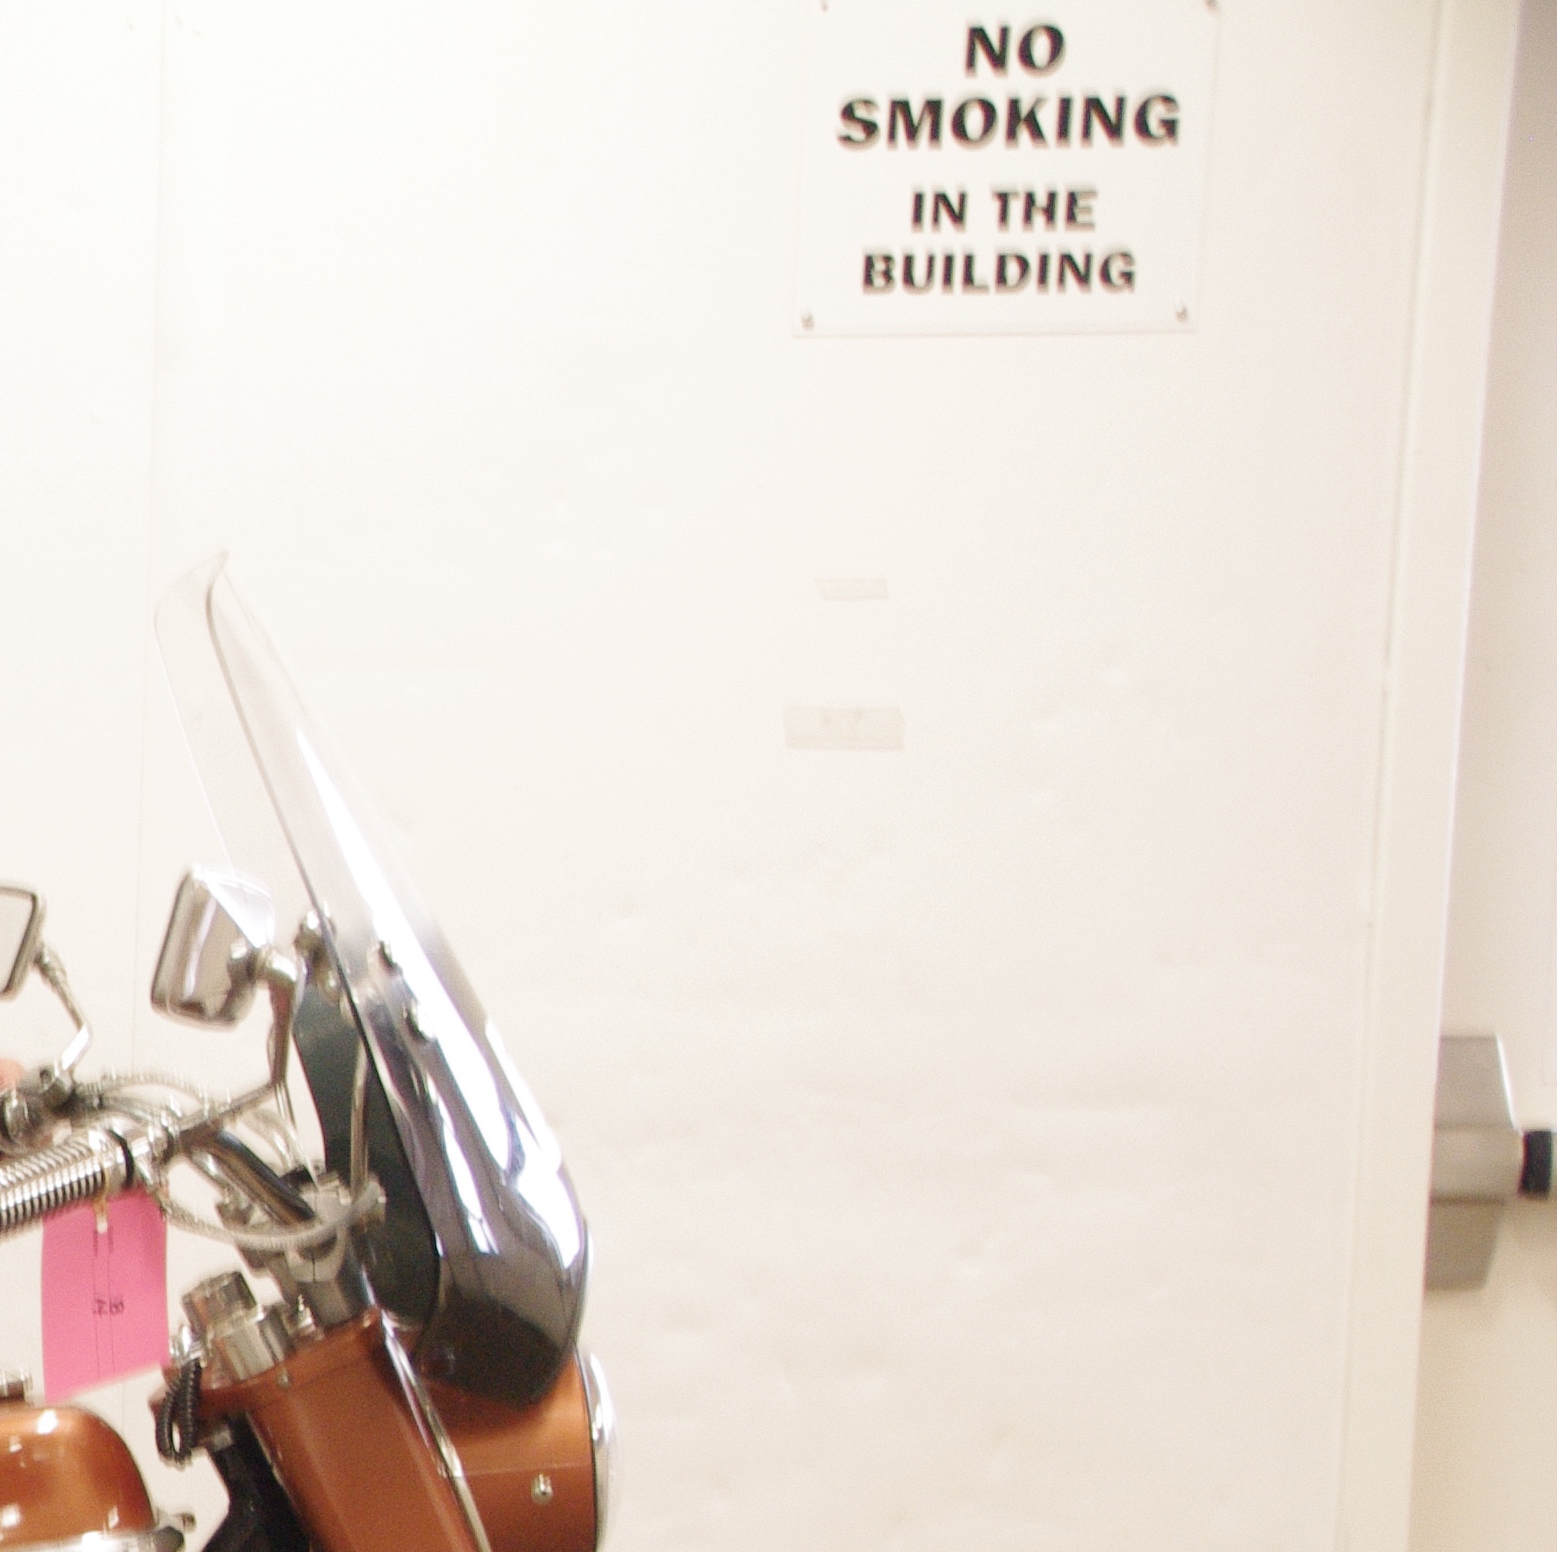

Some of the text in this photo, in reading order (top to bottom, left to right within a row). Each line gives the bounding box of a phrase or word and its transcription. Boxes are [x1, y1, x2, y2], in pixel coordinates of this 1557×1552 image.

[965, 23, 1066, 77] NO
[837, 92, 1181, 150] SMOKING
[911, 184, 1098, 232] IN THE
[861, 247, 1137, 294] BUILDING
